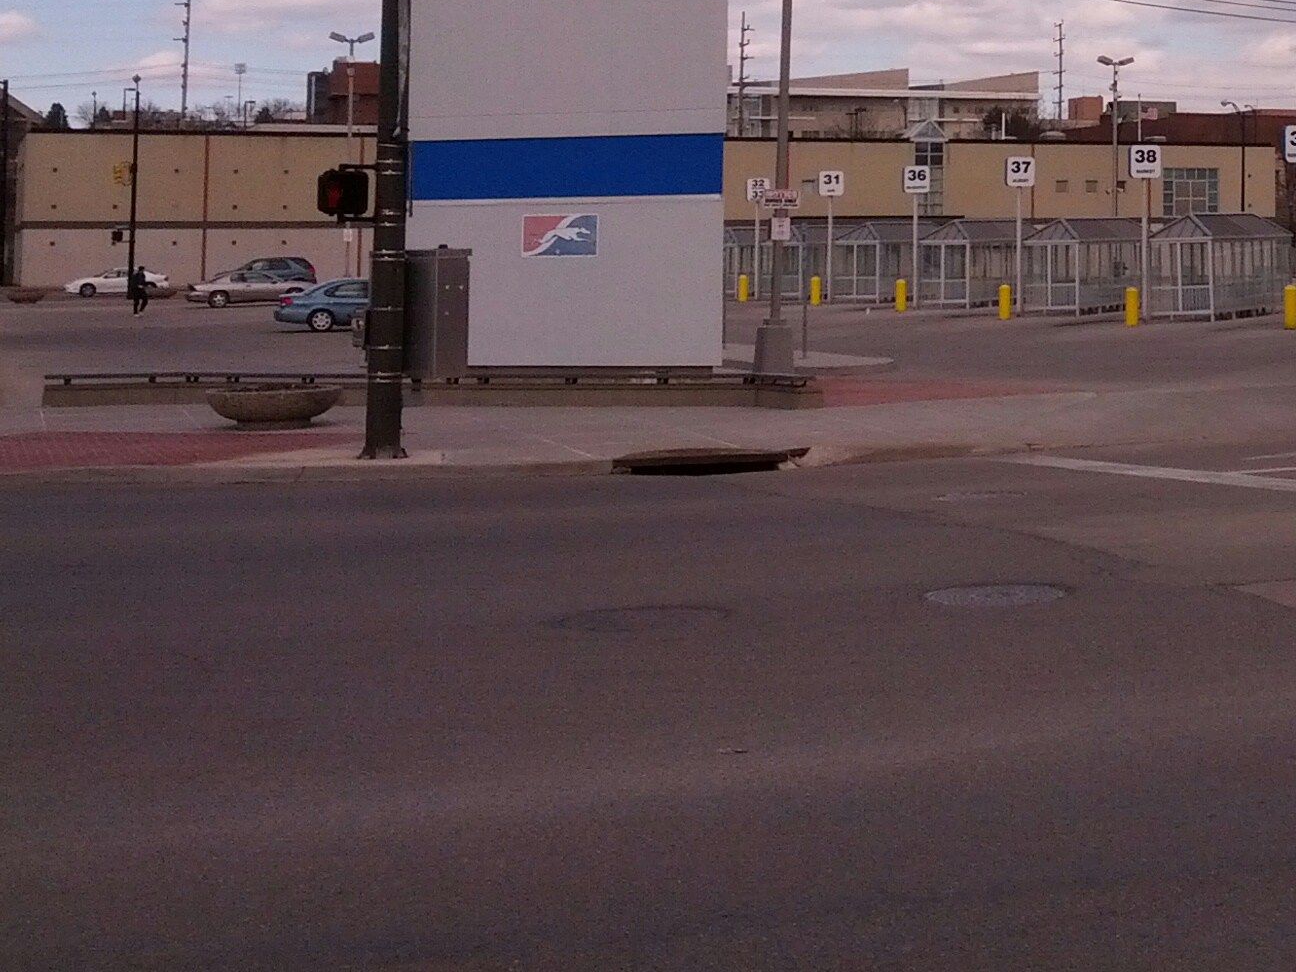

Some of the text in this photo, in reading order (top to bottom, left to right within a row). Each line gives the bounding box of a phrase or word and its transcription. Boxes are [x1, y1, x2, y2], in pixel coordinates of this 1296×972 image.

[1135, 149, 1157, 163] 38
[1011, 160, 1032, 174] 37
[823, 174, 841, 185] 31
[907, 169, 927, 181] 36
[751, 179, 765, 187] 32
